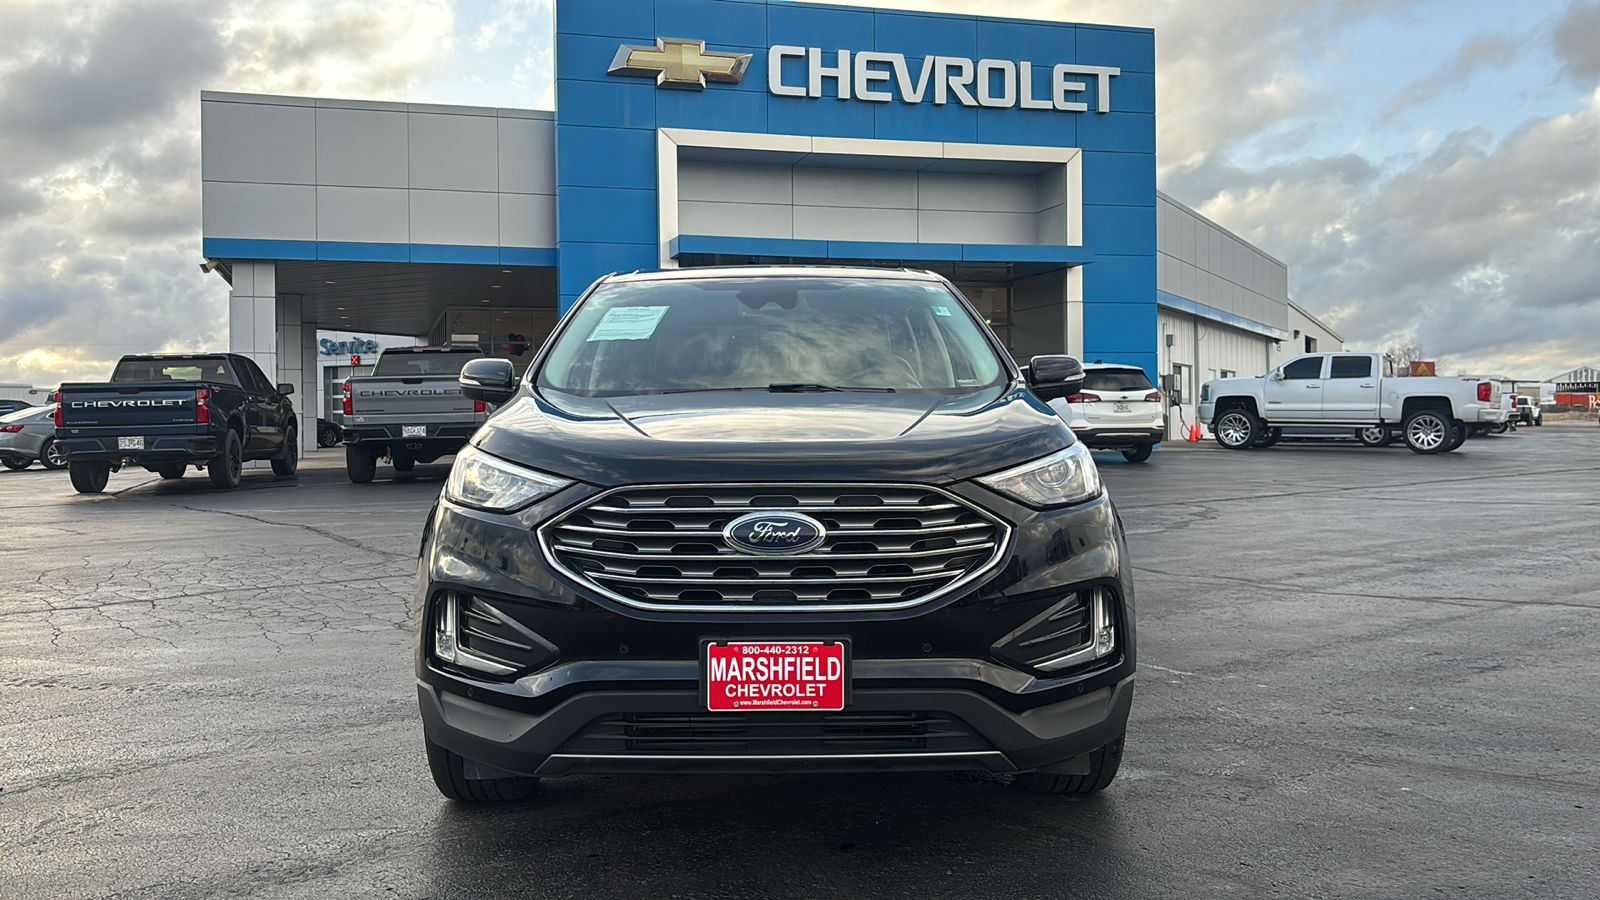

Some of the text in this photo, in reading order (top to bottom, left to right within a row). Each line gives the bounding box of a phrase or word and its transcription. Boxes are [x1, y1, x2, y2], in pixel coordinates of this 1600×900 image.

[768, 44, 1121, 113] CHEVROLET
[319, 336, 375, 356] Service
[71, 399, 187, 409] CHEVROLET
[748, 521, 801, 543] Ford
[742, 646, 809, 655] 800-440-2312
[711, 656, 841, 682] MARSHFIELD
[725, 683, 827, 697] CHEVROLET
